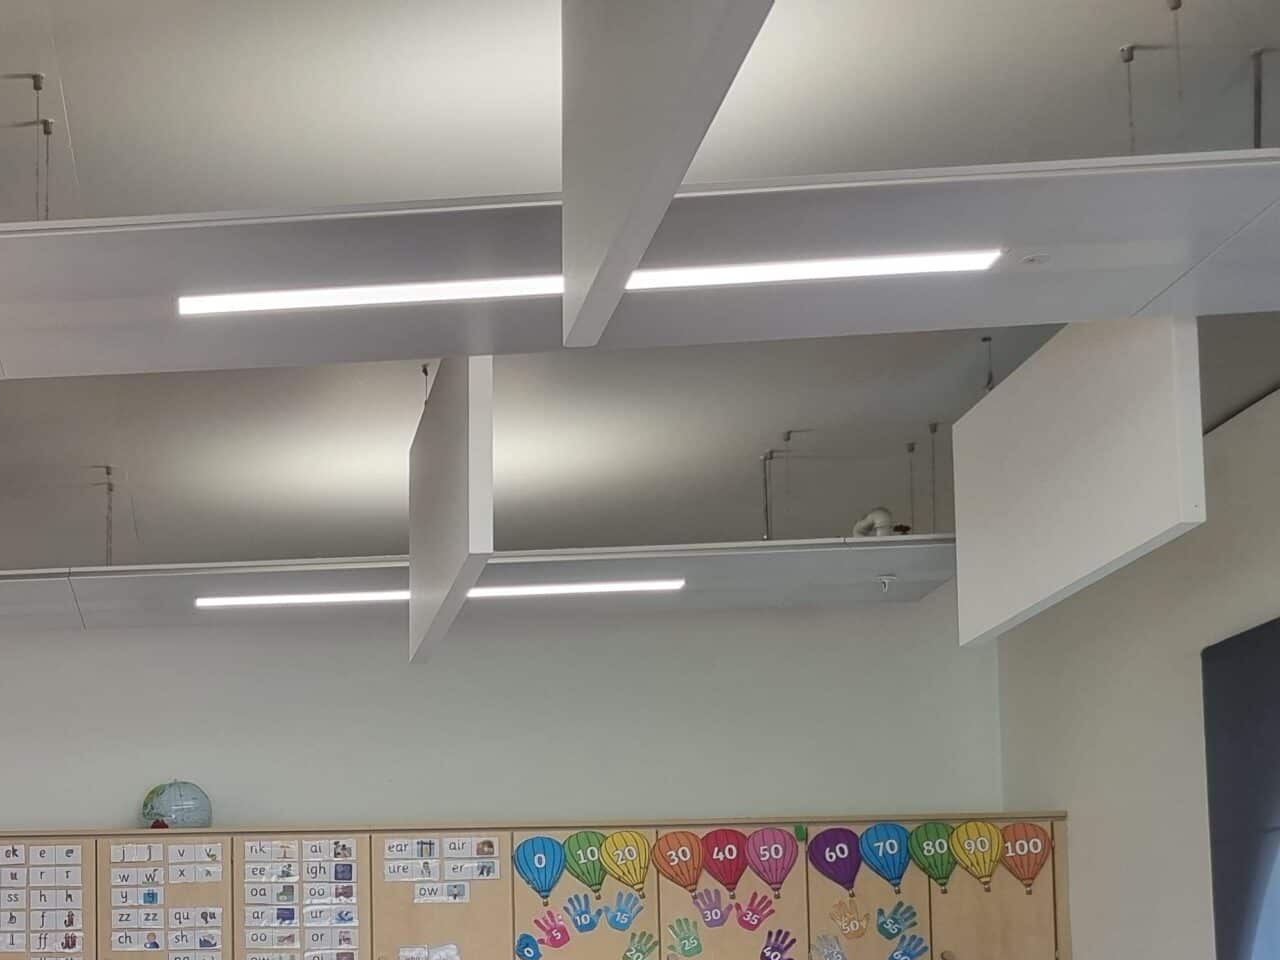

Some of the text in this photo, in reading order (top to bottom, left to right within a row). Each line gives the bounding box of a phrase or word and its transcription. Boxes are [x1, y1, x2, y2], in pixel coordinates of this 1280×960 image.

[388, 843, 408, 852] ear
[449, 841, 466, 851] air
[874, 839, 898, 857] 70
[923, 838, 948, 856] 80
[964, 836, 989, 855] 90
[1004, 838, 1042, 857] 100
[40, 848, 74, 857] e e
[121, 847, 125, 861] j
[178, 849, 185, 857] v
[577, 846, 598, 865] 10
[613, 846, 637, 865] 20
[667, 846, 691, 866] 30
[712, 844, 737, 860] 40
[759, 844, 783, 861] 50
[824, 843, 849, 862] 60
[534, 854, 546, 868] 0
[179, 869, 185, 877] x
[252, 867, 265, 876] ee
[307, 862, 326, 879] igh
[389, 864, 408, 873] ure
[40, 871, 45, 880] r
[119, 874, 129, 882] w
[40, 891, 47, 902] h
[120, 891, 127, 903] y
[250, 888, 266, 897] oa
[309, 888, 324, 897] oo
[419, 887, 438, 896] ow
[7, 894, 19, 902] ss
[40, 911, 46, 928] f
[118, 913, 158, 922] zz zz
[174, 911, 216, 924] qu qu
[252, 911, 264, 920] ar
[311, 910, 323, 919] ur
[574, 913, 591, 925] 10
[615, 912, 630, 924] 15
[703, 909, 721, 922] 30
[742, 910, 760, 925] 35
[841, 920, 860, 935] 50
[882, 919, 900, 934] 55
[118, 930, 132, 944] ch
[175, 929, 189, 943] sh
[251, 933, 266, 942] oo
[311, 933, 324, 942] or
[551, 928, 562, 940] 5
[681, 937, 697, 951] 25
[524, 946, 534, 958] 0
